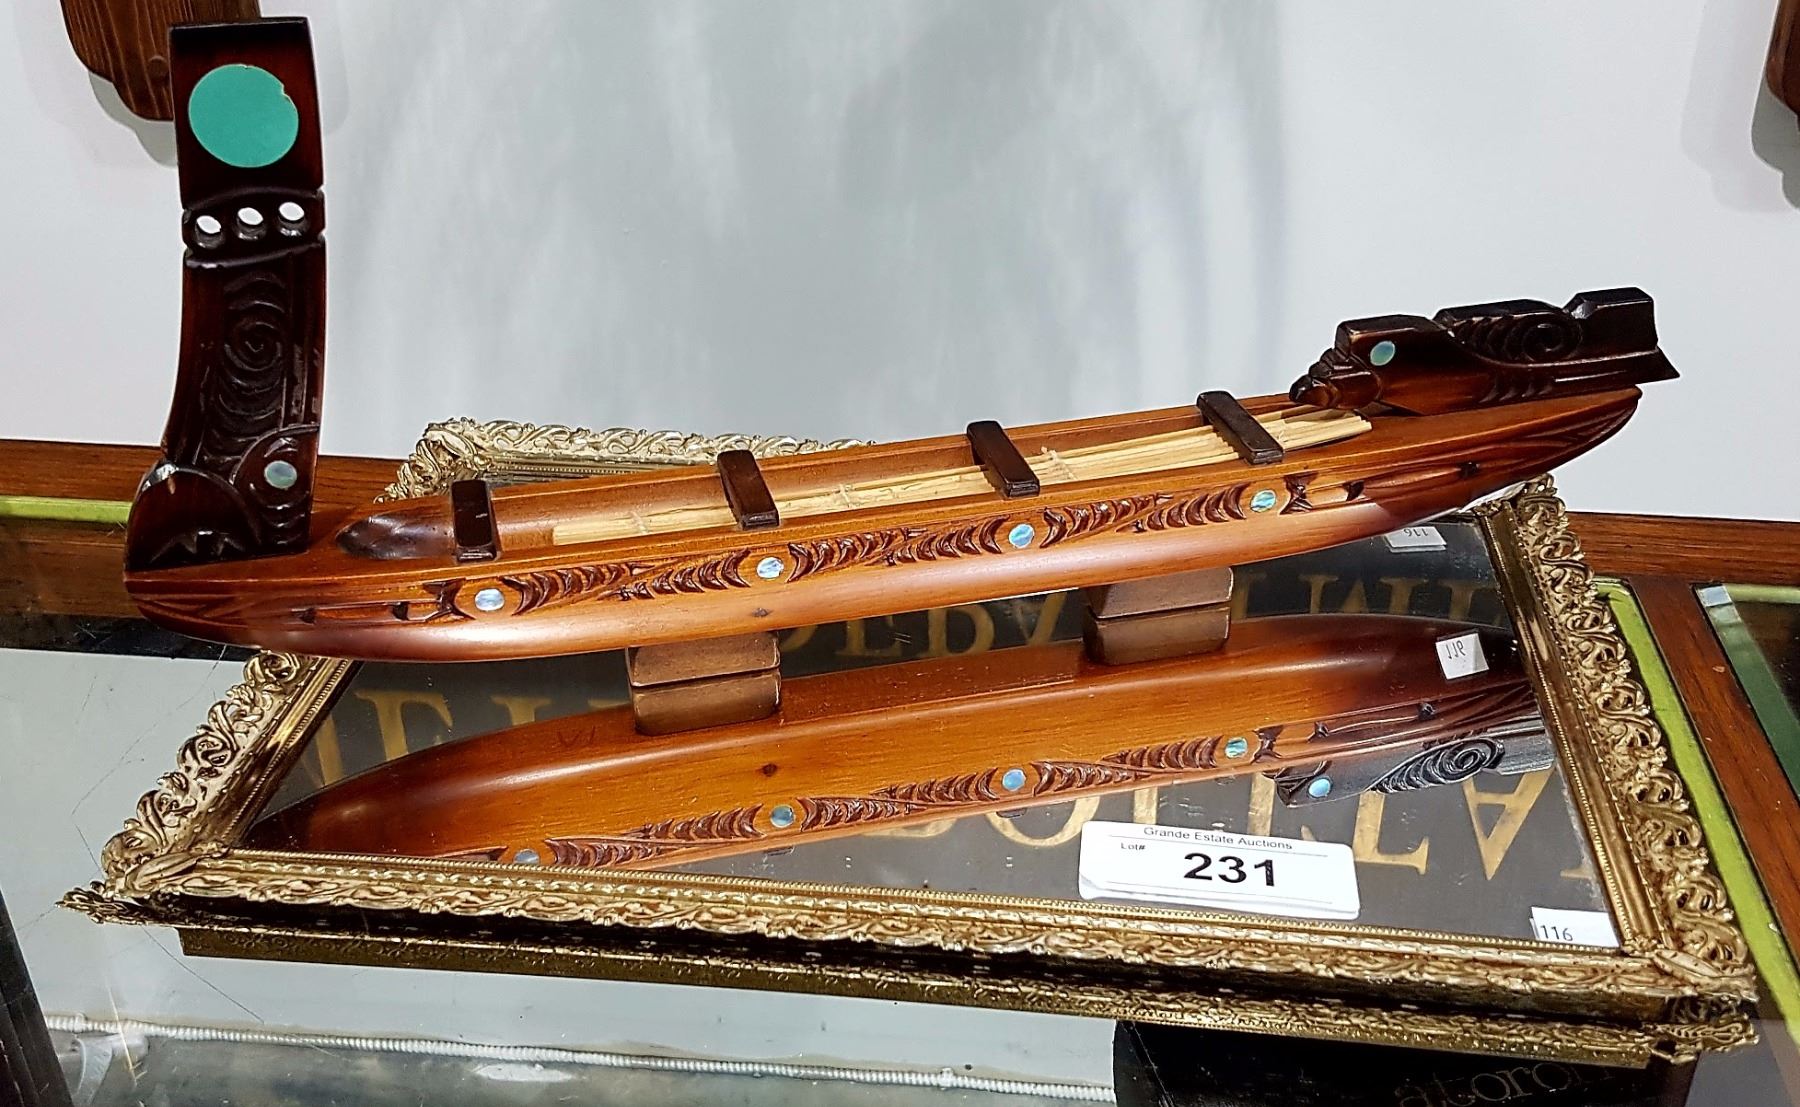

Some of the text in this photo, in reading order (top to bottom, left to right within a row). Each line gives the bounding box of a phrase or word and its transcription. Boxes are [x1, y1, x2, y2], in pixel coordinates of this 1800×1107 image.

[1120, 841, 1147, 851] Lot#
[1143, 826, 1294, 850] Grande Estate Auctions
[1183, 852, 1276, 887] 231
[1540, 924, 1574, 942] 116
